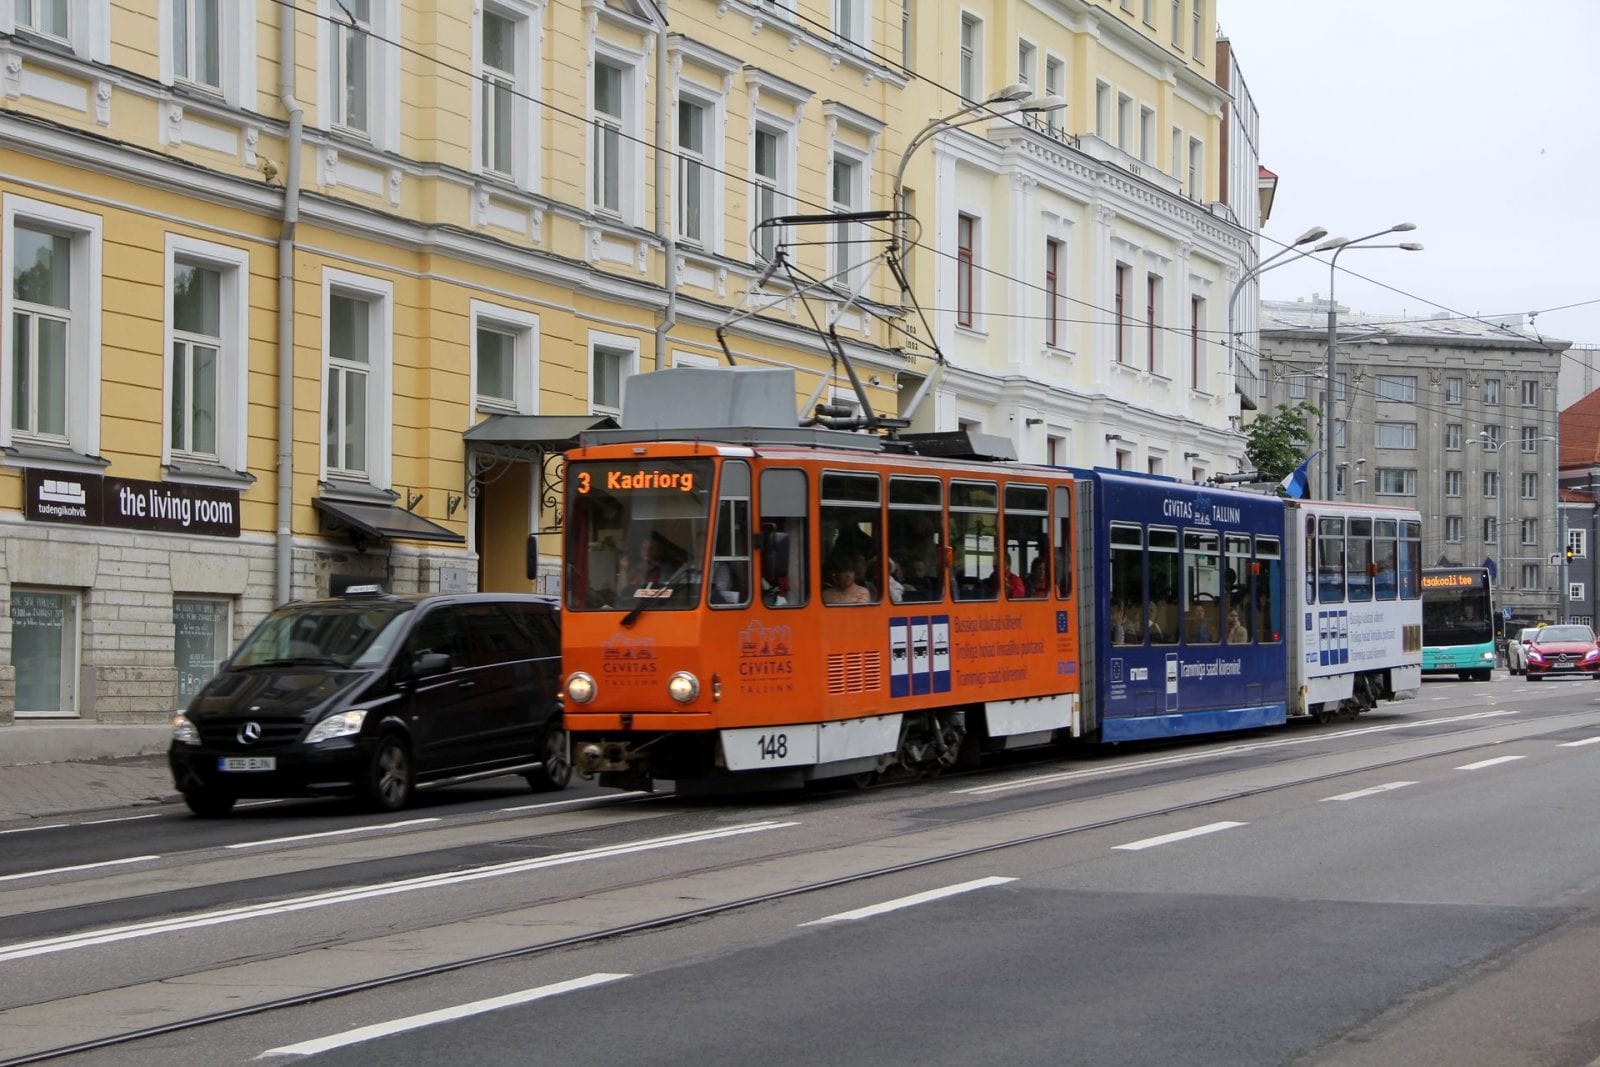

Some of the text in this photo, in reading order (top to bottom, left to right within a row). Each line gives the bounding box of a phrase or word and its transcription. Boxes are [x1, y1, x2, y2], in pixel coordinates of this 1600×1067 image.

[577, 470, 694, 494] 3 Kadriorg
[38, 503, 87, 518] tudengikohvik
[120, 486, 233, 527] the living room
[1212, 505, 1240, 525] TALLINN
[1459, 575, 1473, 586] tee
[603, 678, 658, 687] TALLINN
[740, 684, 793, 694] TALLINN
[757, 733, 788, 760] 148
